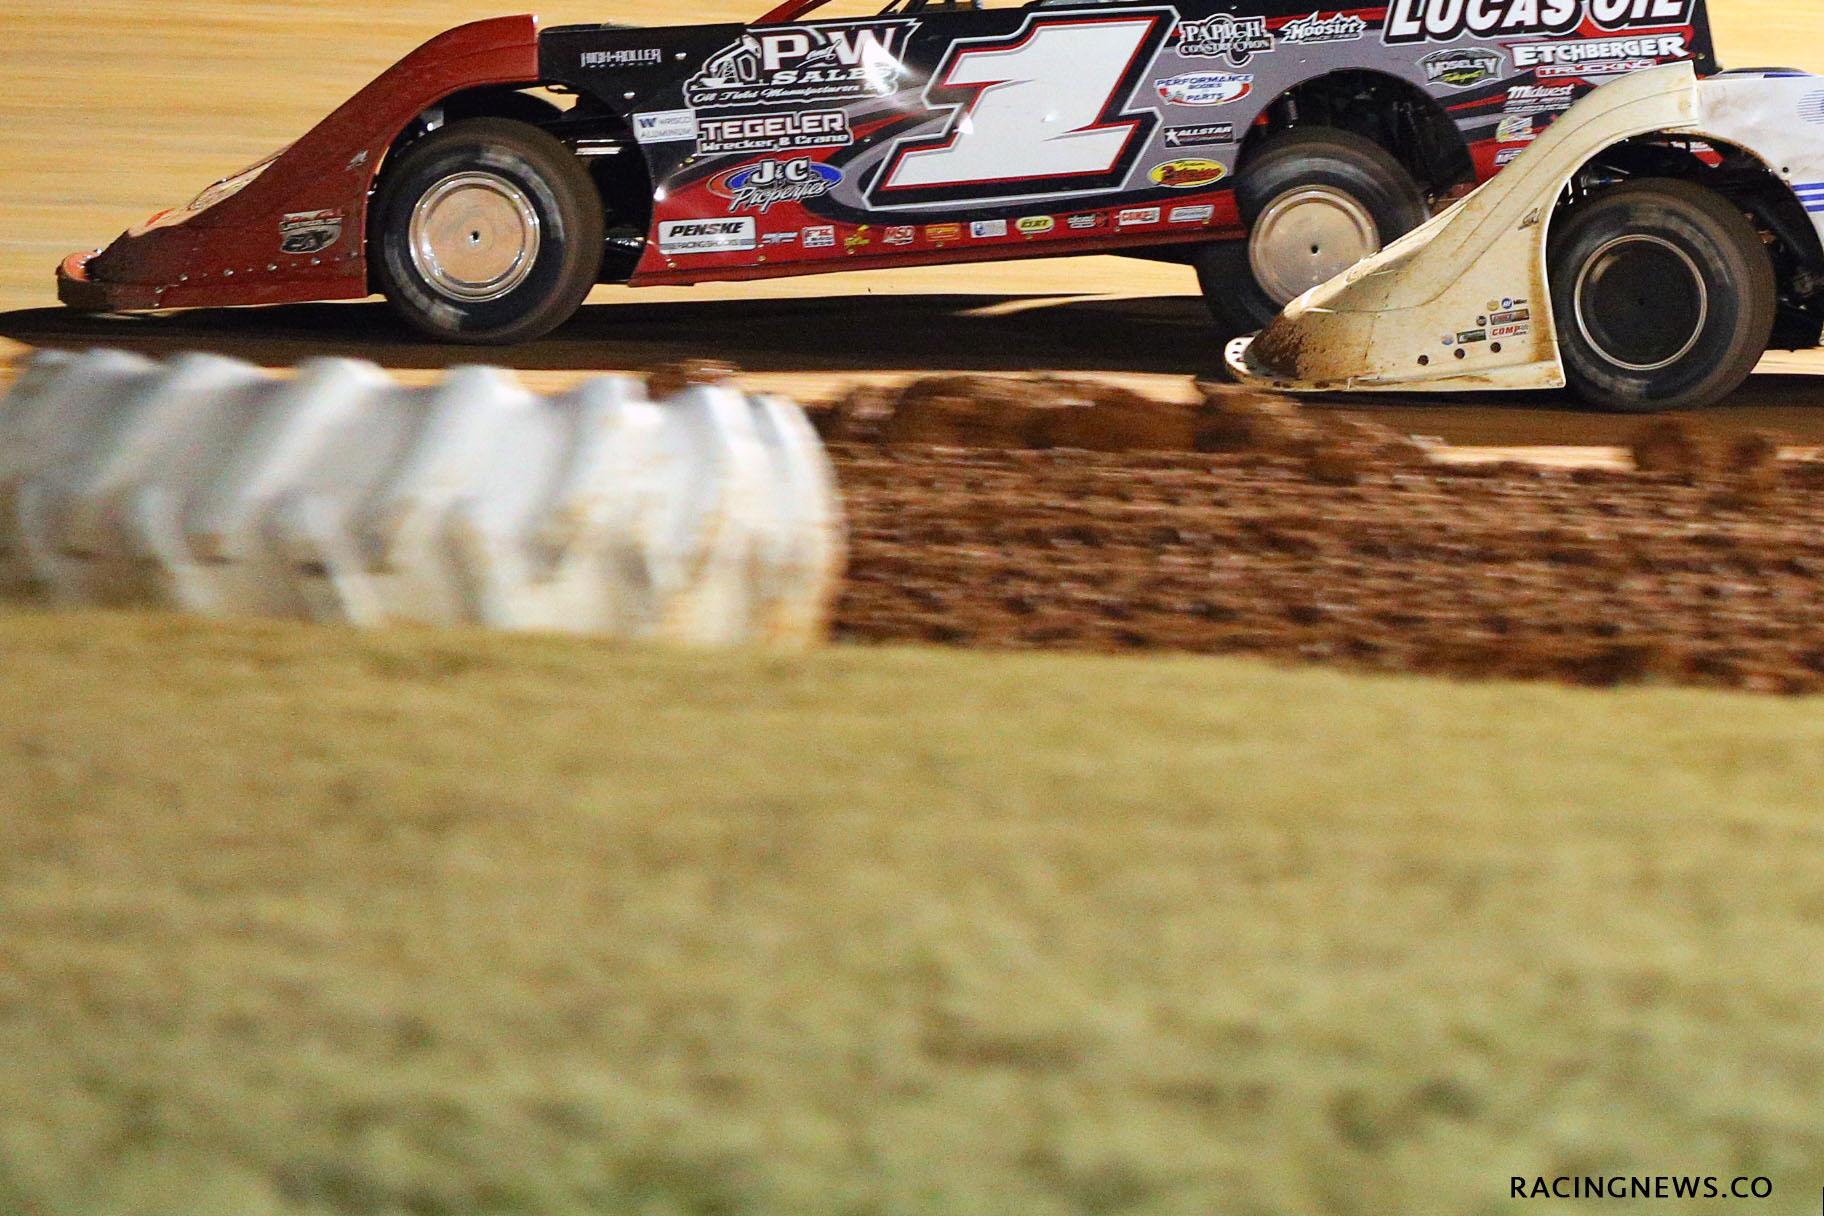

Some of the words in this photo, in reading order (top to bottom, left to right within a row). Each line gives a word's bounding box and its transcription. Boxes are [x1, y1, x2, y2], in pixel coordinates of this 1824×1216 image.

[1187, 21, 1261, 43] PAPICH
[1288, 21, 1361, 41] Hoosier
[762, 34, 810, 71] P
[825, 27, 897, 67] W
[1513, 36, 1690, 67] ETCHBERGER
[1156, 74, 1252, 87] PERFORMANCE
[1507, 83, 1575, 100] Midwest
[881, 16, 1159, 189] 1
[701, 113, 844, 141] TEGELER
[1178, 127, 1233, 137] ALLSTAR
[702, 138, 774, 152] Wrecker
[795, 133, 849, 145] Crane
[729, 180, 828, 214] Properties
[669, 221, 745, 238] PENSKE
[1492, 325, 1520, 336] COMP
